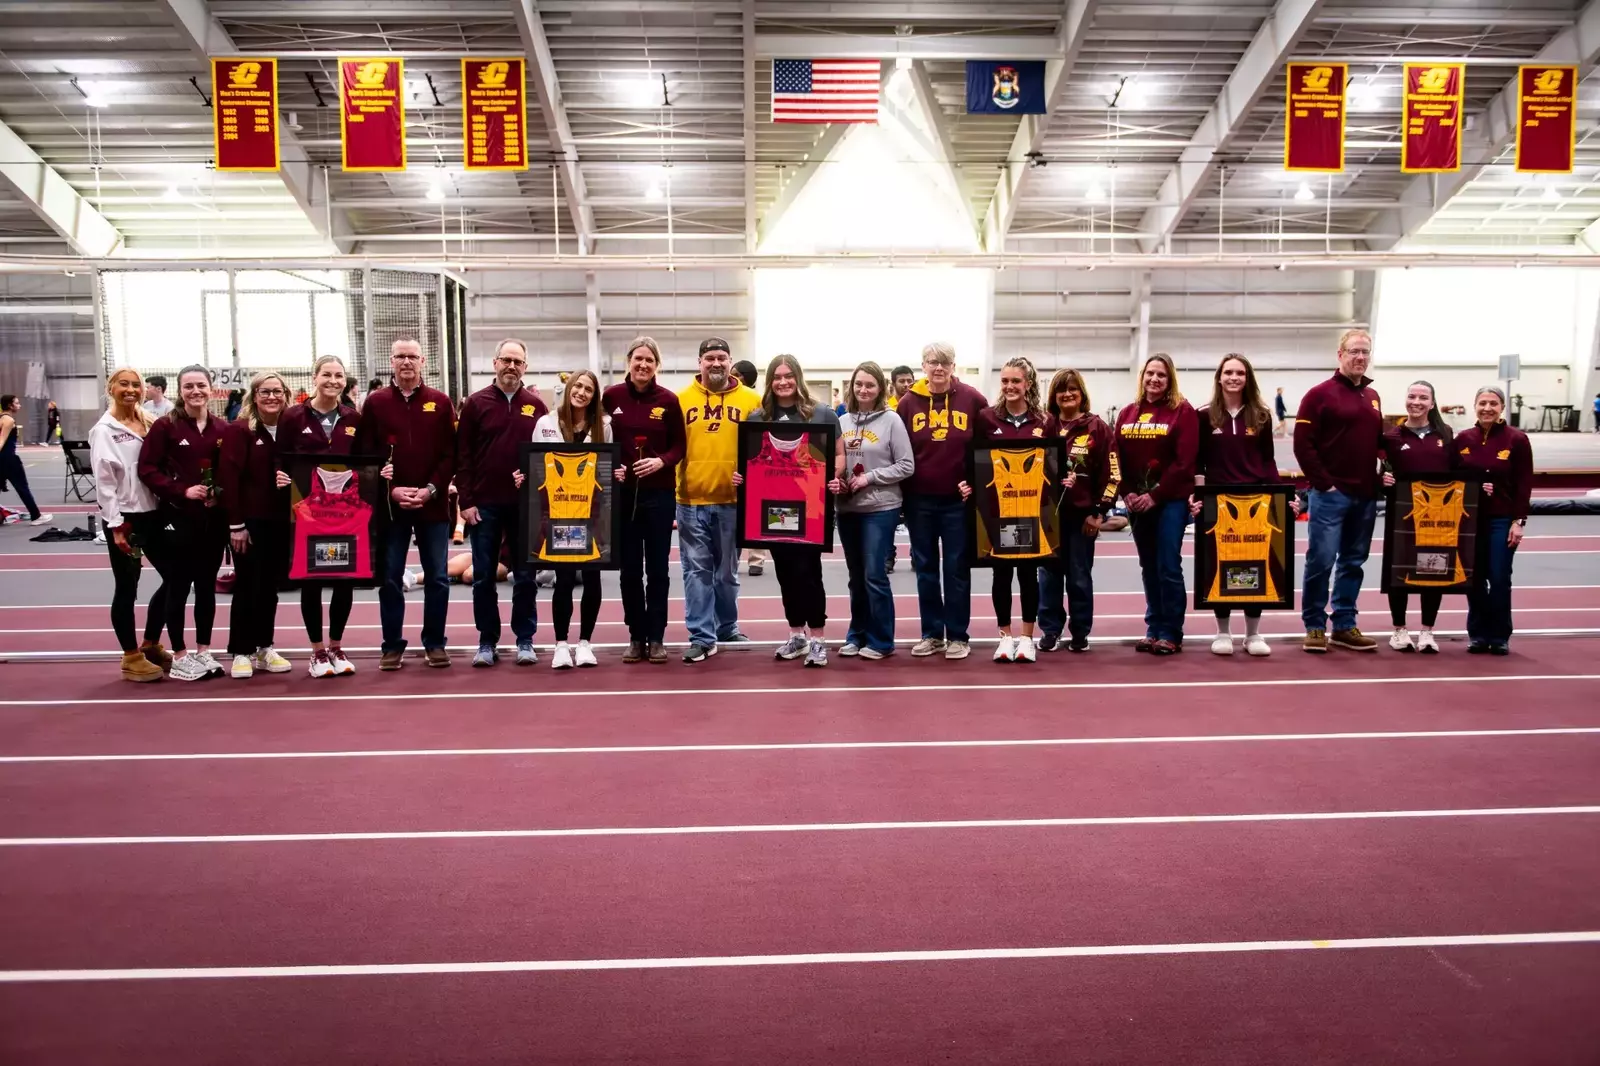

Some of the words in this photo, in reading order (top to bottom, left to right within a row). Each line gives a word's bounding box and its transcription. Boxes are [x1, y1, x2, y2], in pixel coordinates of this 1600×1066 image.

[686, 405, 741, 425] CMU
[912, 408, 968, 432] CMU
[1221, 534, 1242, 543] CENTRAL
[1243, 534, 1266, 543] MICHIGAN
